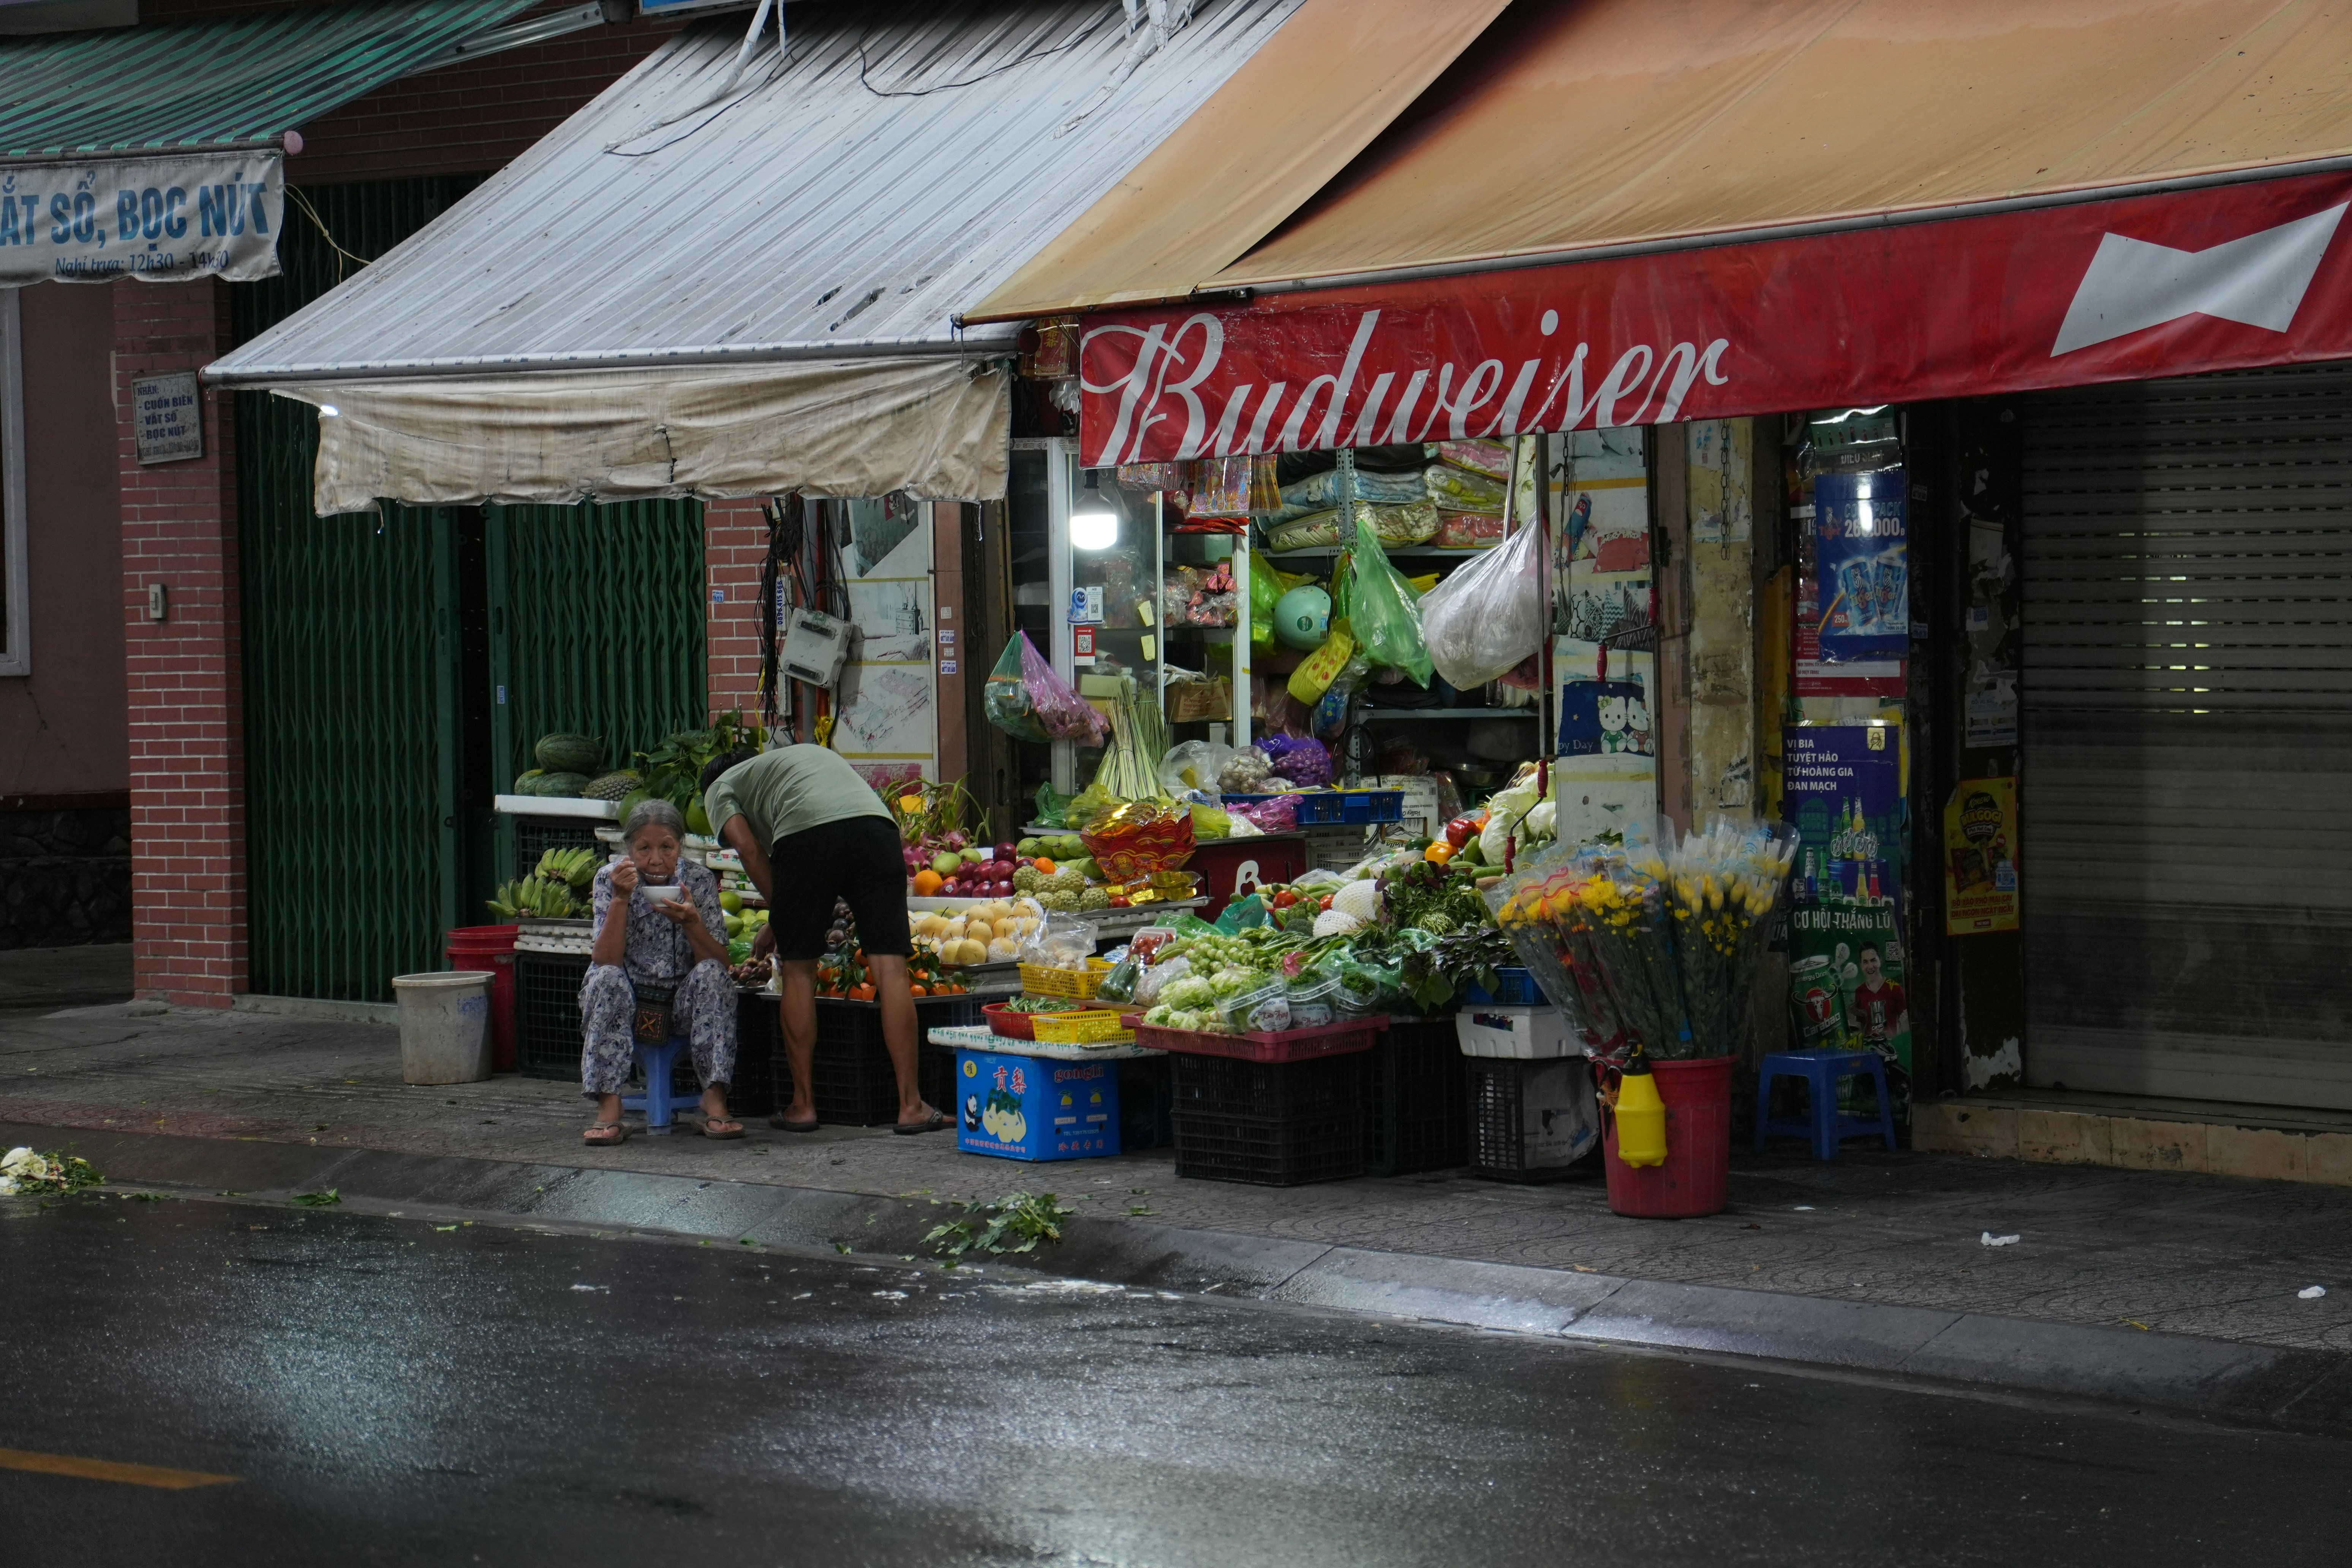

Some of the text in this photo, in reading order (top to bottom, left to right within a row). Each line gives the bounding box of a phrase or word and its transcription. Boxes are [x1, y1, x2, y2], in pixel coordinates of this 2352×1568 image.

[50, 171, 105, 248] SỔ,
[117, 187, 187, 251] BỌC
[199, 172, 268, 237] NÚT
[55, 255, 88, 275] Nghỉ
[91, 257, 124, 273] trưa:
[130, 253, 173, 273] 12h30
[189, 250, 229, 270] 14h30
[1080, 309, 1729, 467] Budweiser
[1573, 739, 1593, 753] Day
[1787, 740, 1815, 751] VỊ BIA
[1787, 751, 1838, 765] TUYỆT HẢO
[1802, 765, 1836, 776] HOÀNG
[1837, 767, 1854, 776] GIA
[1787, 781, 1837, 793] ĐAN MẠCH
[1960, 809, 2003, 827] BULGOGI
[1794, 910, 1809, 929] CƠ
[1813, 907, 1830, 932] HỘI
[1834, 907, 1873, 929] THẮNG
[1877, 910, 1893, 929] LỚ
[1796, 974, 1815, 983] Energy
[1804, 1012, 1841, 1038] Carabao
[993, 1065, 1027, 1095] 贡梨
[1054, 1064, 1104, 1083] gongli
